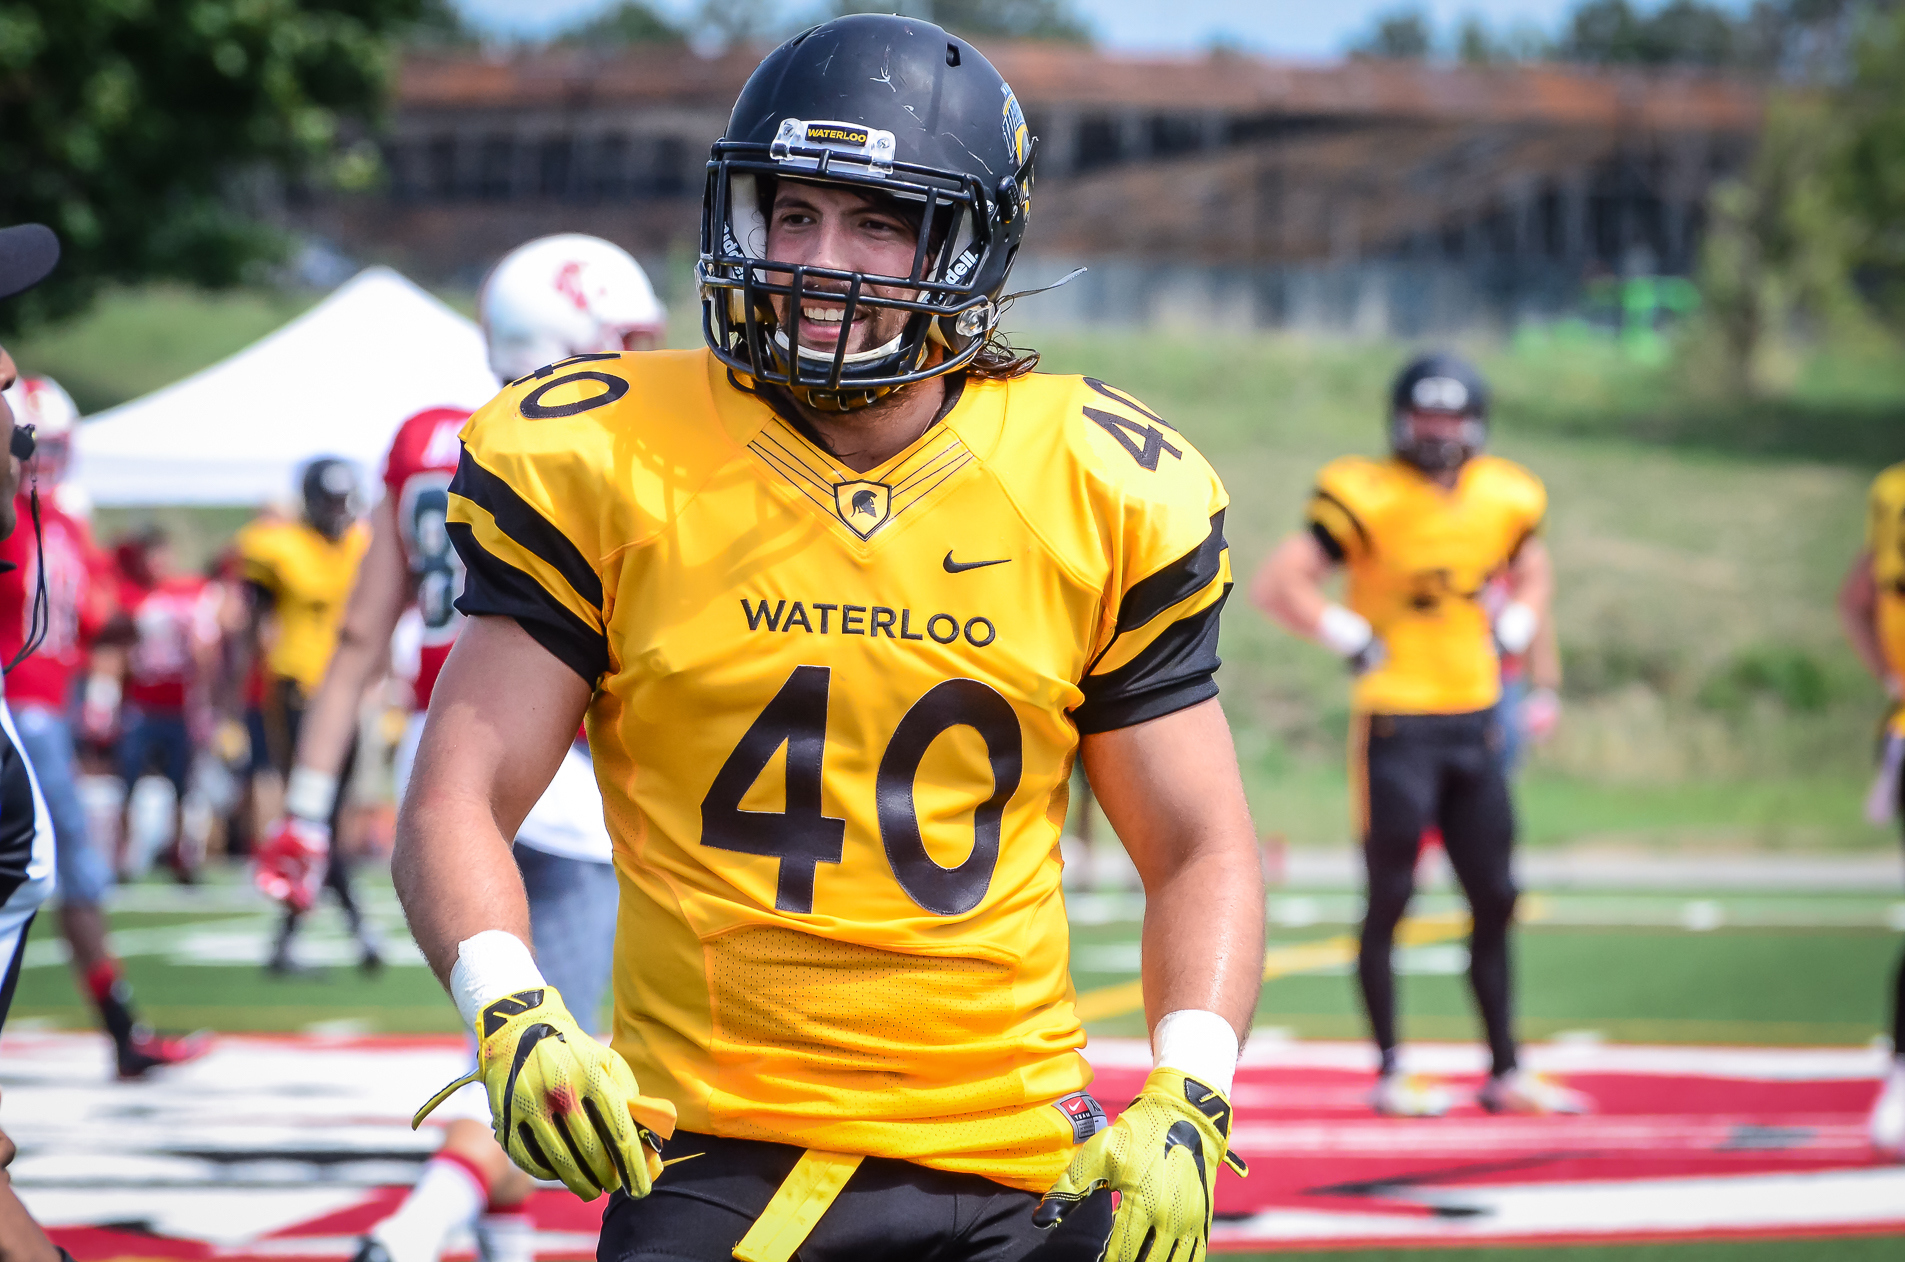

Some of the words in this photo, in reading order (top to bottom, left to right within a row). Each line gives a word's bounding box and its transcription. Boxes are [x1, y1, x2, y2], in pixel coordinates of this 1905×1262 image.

[808, 128, 867, 143] WATERLOO
[740, 598, 997, 647] WATERLOO
[700, 664, 1023, 916] 40
